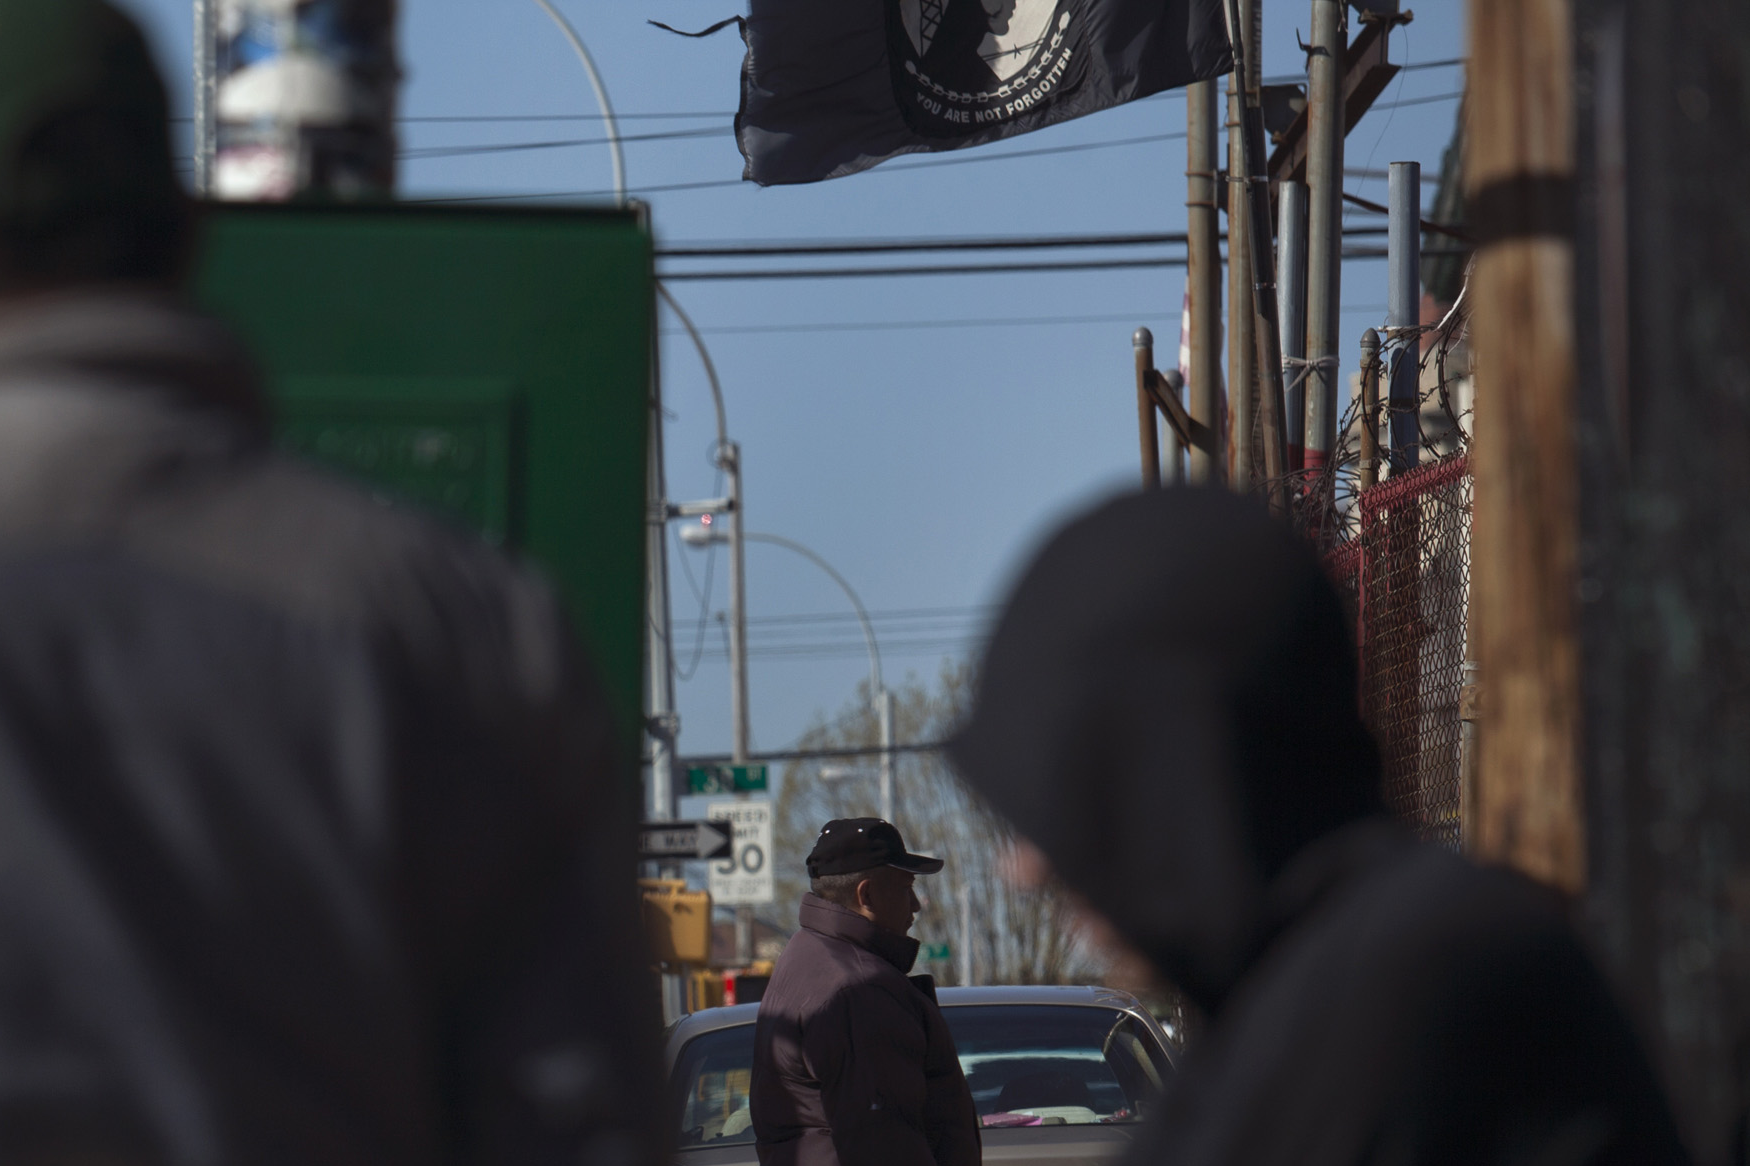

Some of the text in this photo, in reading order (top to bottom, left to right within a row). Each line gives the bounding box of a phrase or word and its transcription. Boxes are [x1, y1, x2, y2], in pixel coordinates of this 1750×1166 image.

[916, 47, 1073, 123] YOU ARE NOT FORGOTTEN
